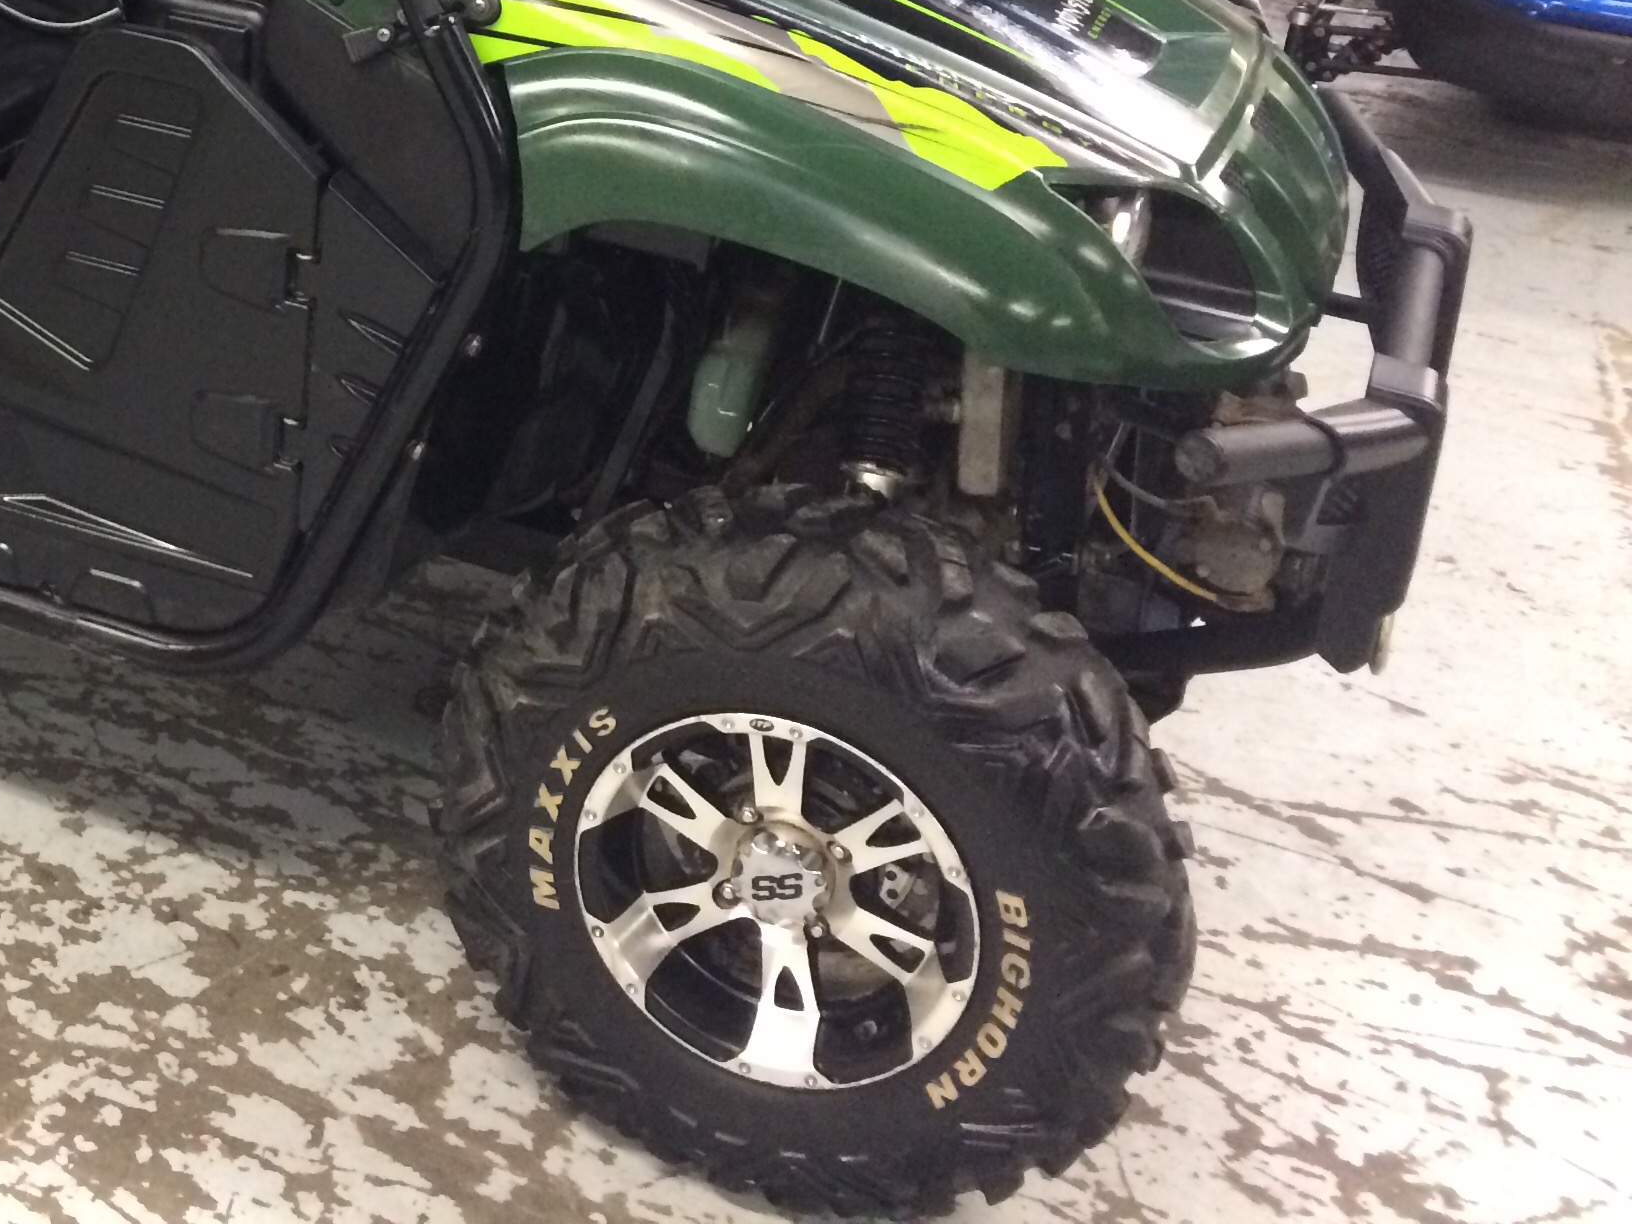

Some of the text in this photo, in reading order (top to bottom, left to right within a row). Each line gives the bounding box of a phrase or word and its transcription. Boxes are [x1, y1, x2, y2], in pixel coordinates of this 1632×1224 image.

[528, 705, 619, 910] MAXXIS
[752, 873, 803, 901] SS
[924, 888, 1032, 1110] BIGHORN
